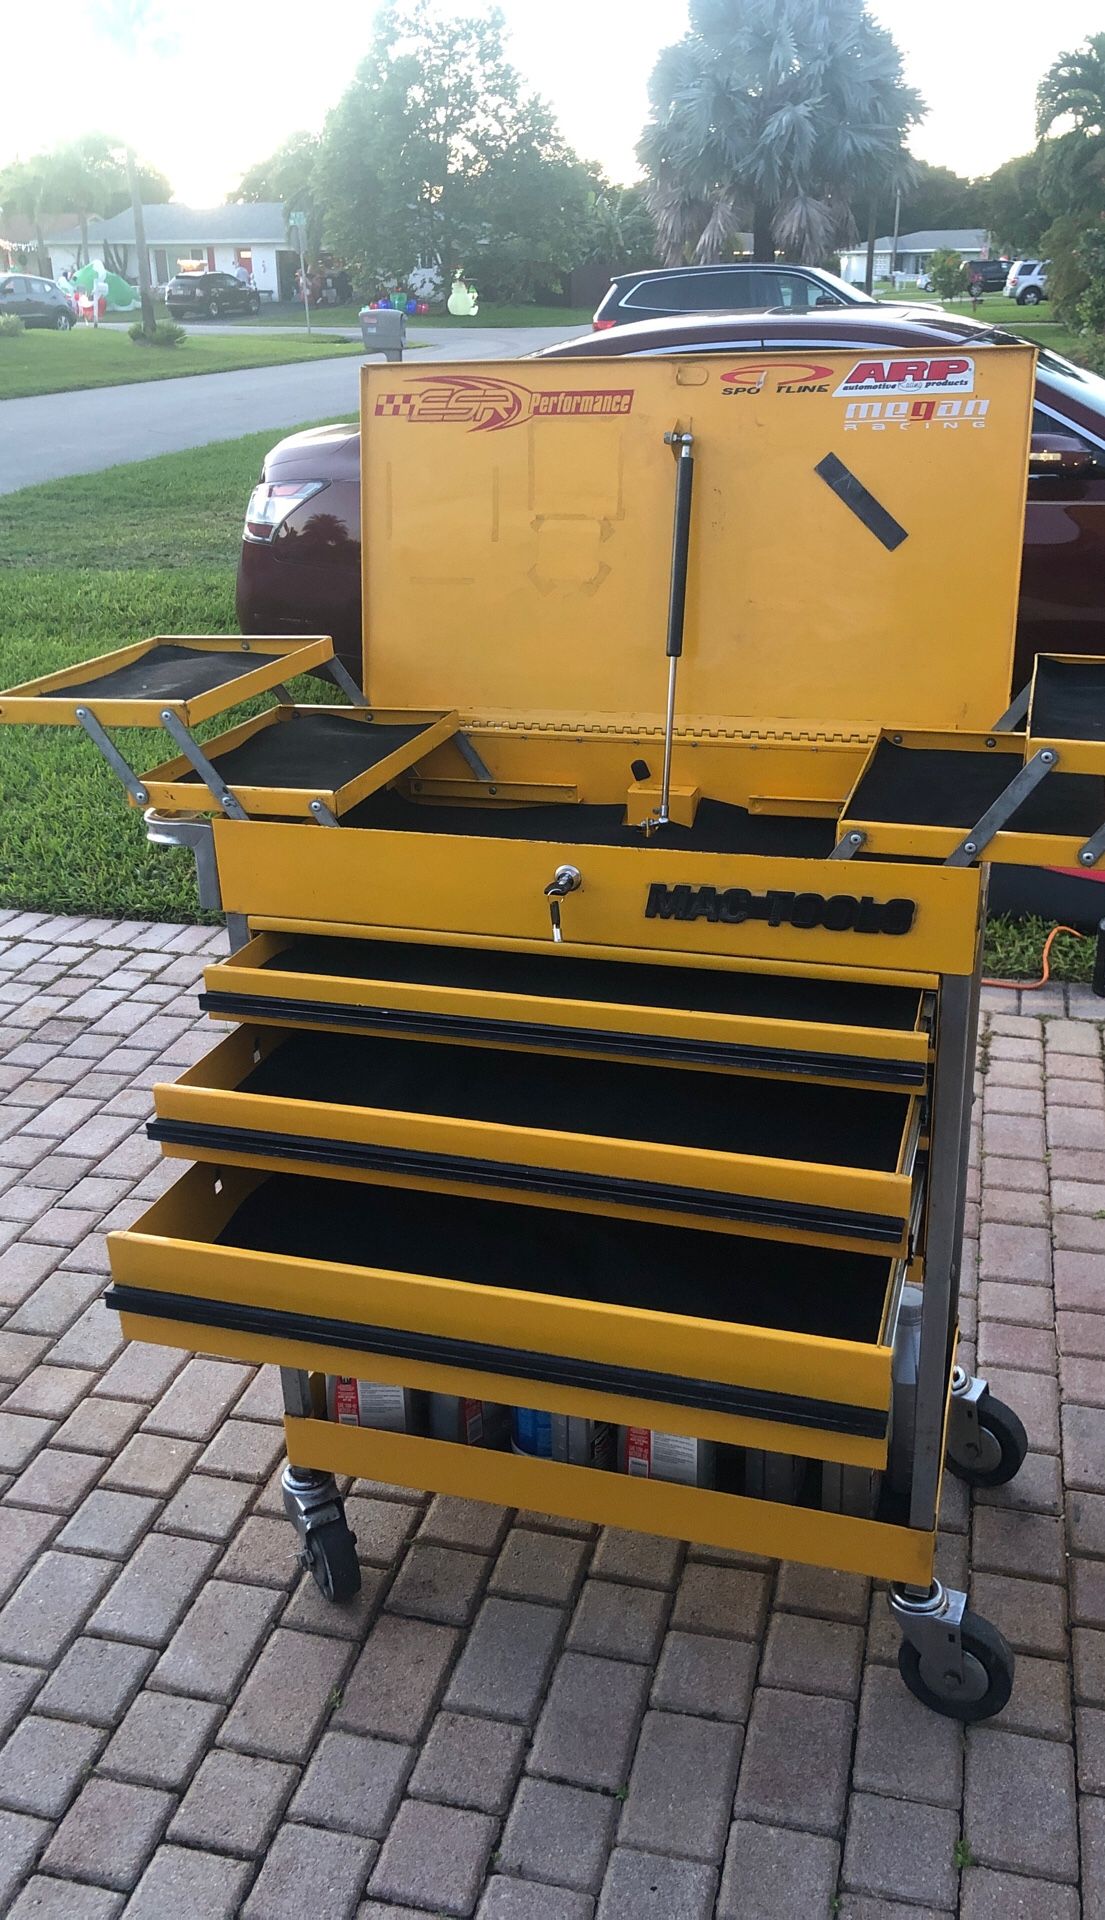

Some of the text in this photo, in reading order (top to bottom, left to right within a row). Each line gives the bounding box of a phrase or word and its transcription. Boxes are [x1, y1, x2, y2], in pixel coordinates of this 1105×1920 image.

[845, 359, 969, 384] ARP
[722, 384, 830, 396] SPOTLINE
[842, 381, 897, 391] automotive
[924, 379, 968, 388] products
[528, 391, 631, 415] Performance
[845, 399, 990, 422] megan
[645, 883, 916, 936] MAC TOOLS
